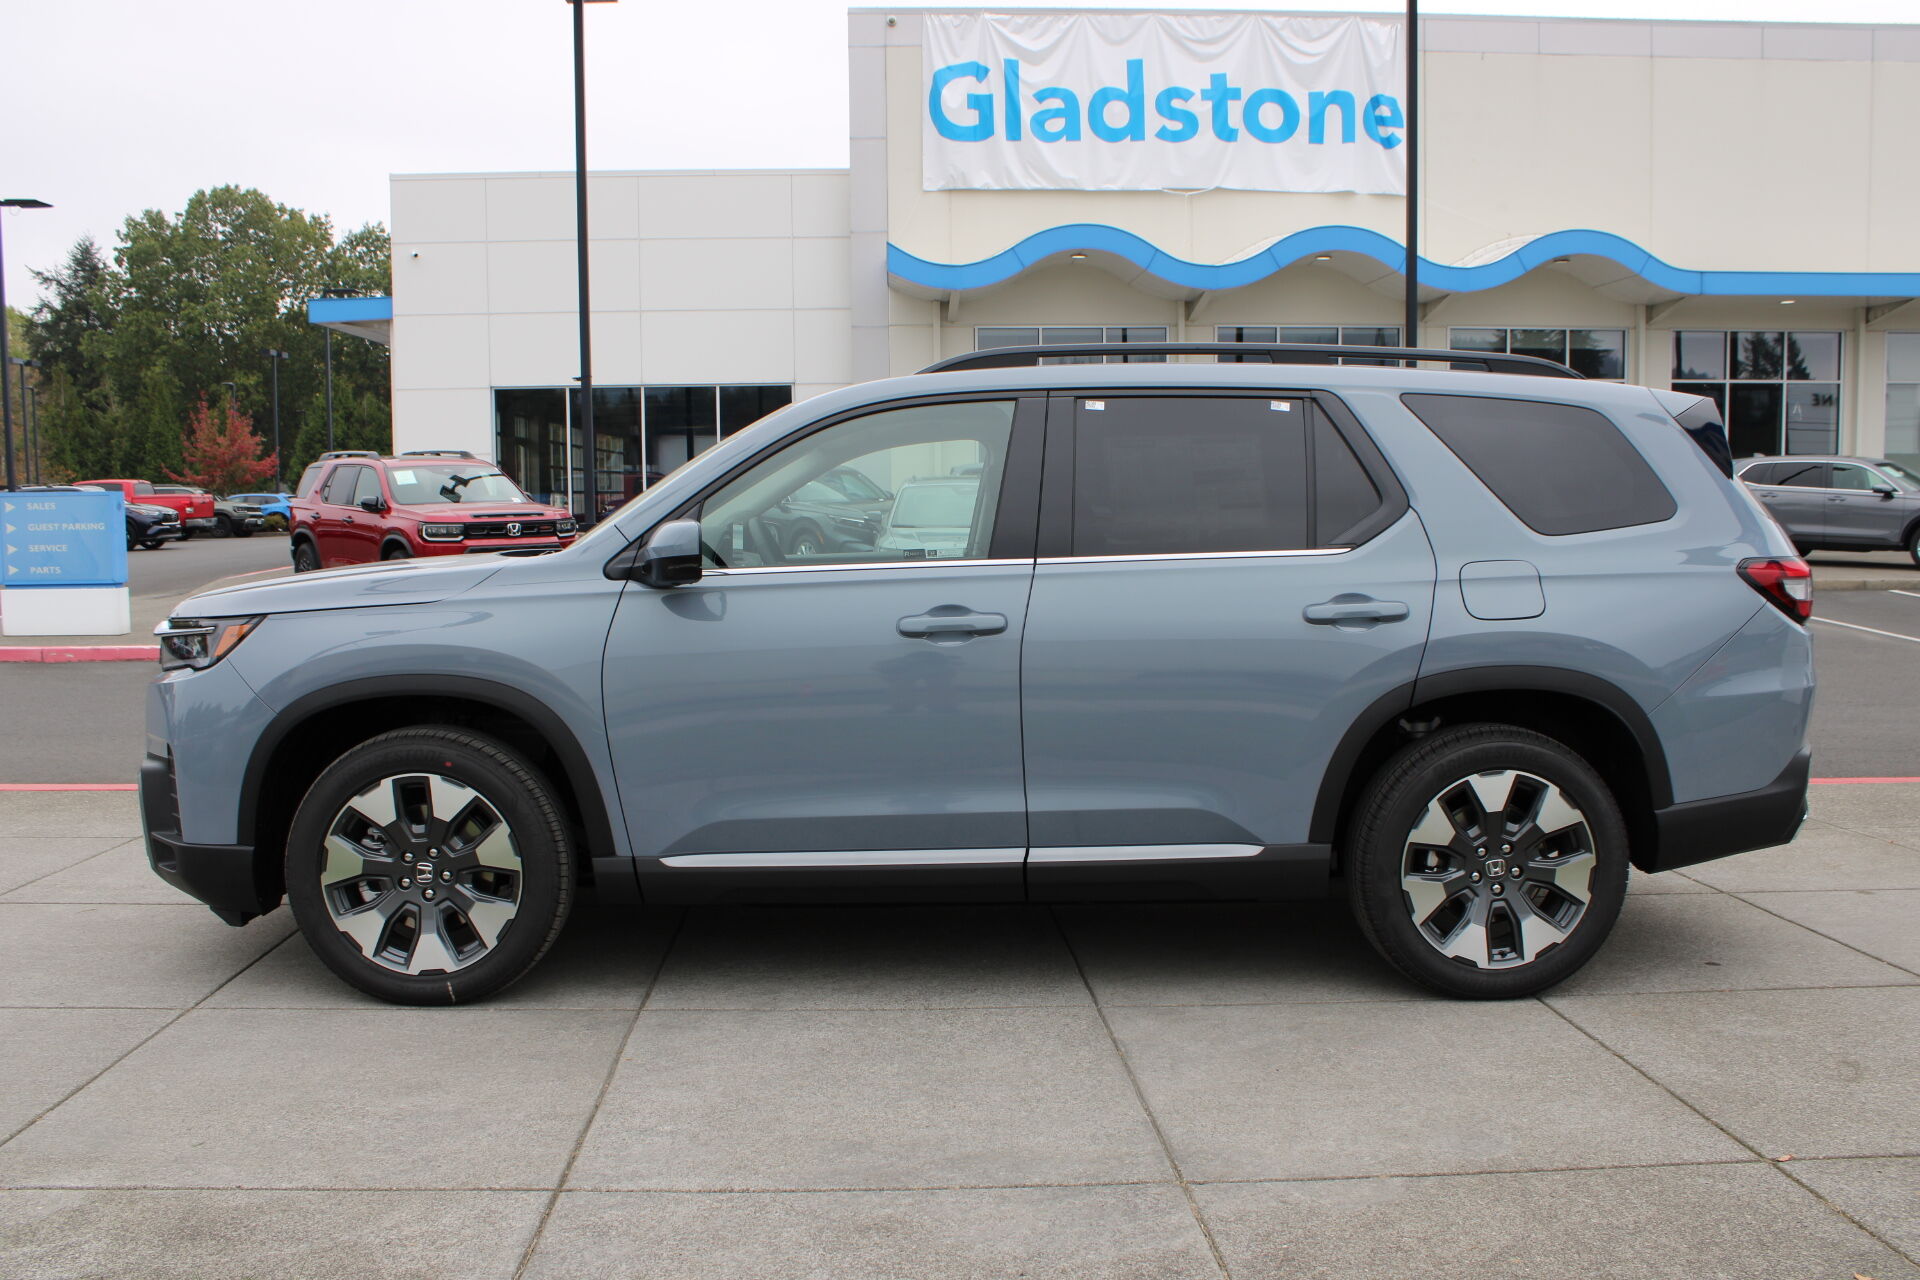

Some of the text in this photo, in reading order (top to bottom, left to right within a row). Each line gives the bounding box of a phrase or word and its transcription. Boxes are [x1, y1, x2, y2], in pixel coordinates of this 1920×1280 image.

[929, 59, 1405, 150] Gladstone
[26, 502, 56, 511] SALES
[27, 522, 105, 532] GUEST PARKING
[28, 544, 68, 552] SERVICE
[30, 565, 62, 574] PARTS
